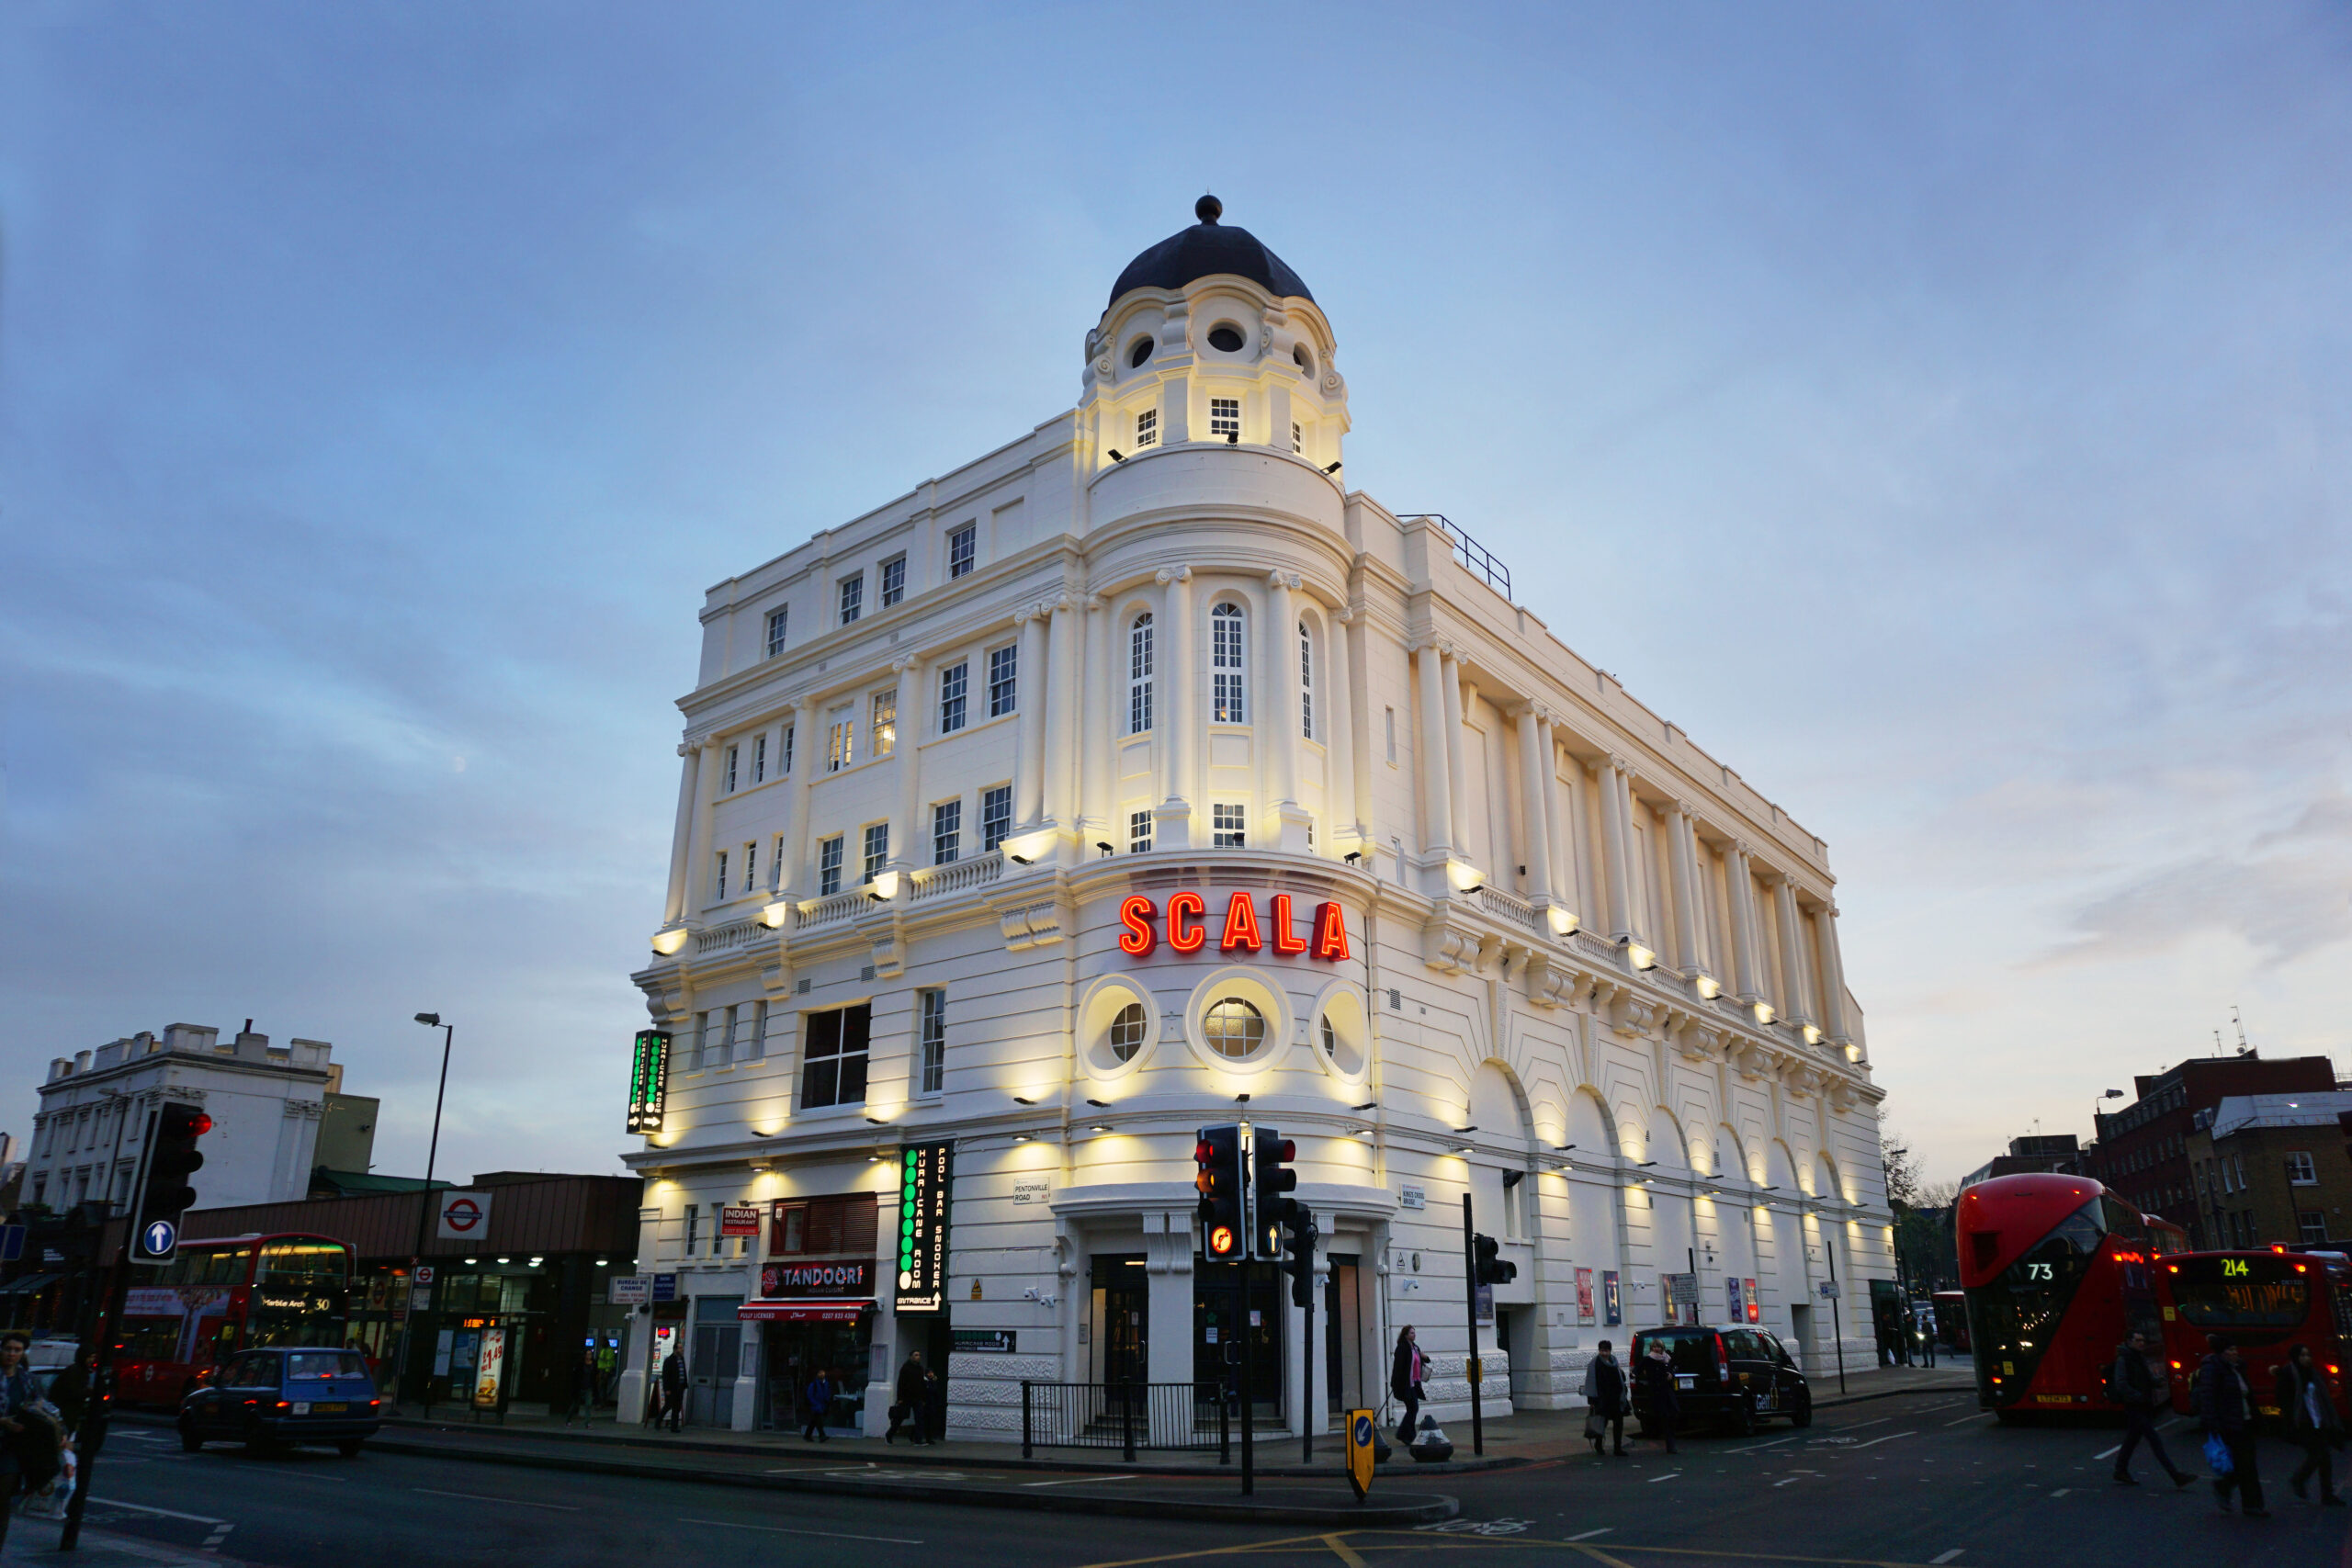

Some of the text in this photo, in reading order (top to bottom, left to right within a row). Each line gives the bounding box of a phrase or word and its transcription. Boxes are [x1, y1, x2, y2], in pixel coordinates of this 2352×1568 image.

[1119, 892, 1350, 962] SCALA
[639, 1037, 647, 1085] HURRICANE
[654, 1038, 667, 1113] HURRICANE ROOM
[1014, 1184, 1047, 1192] PENTONVILLE
[935, 1190, 944, 1216] BAR
[725, 1210, 757, 1218] INDIAN
[911, 1149, 926, 1289] HURRICANE ROOM
[933, 1224, 943, 1289] SNOOKER
[785, 1266, 862, 1285] TANDOORI
[2028, 1263, 2053, 1280] 73
[2221, 1258, 2249, 1276] 214
[263, 1298, 288, 1307] Marble
[314, 1298, 330, 1311] 30
